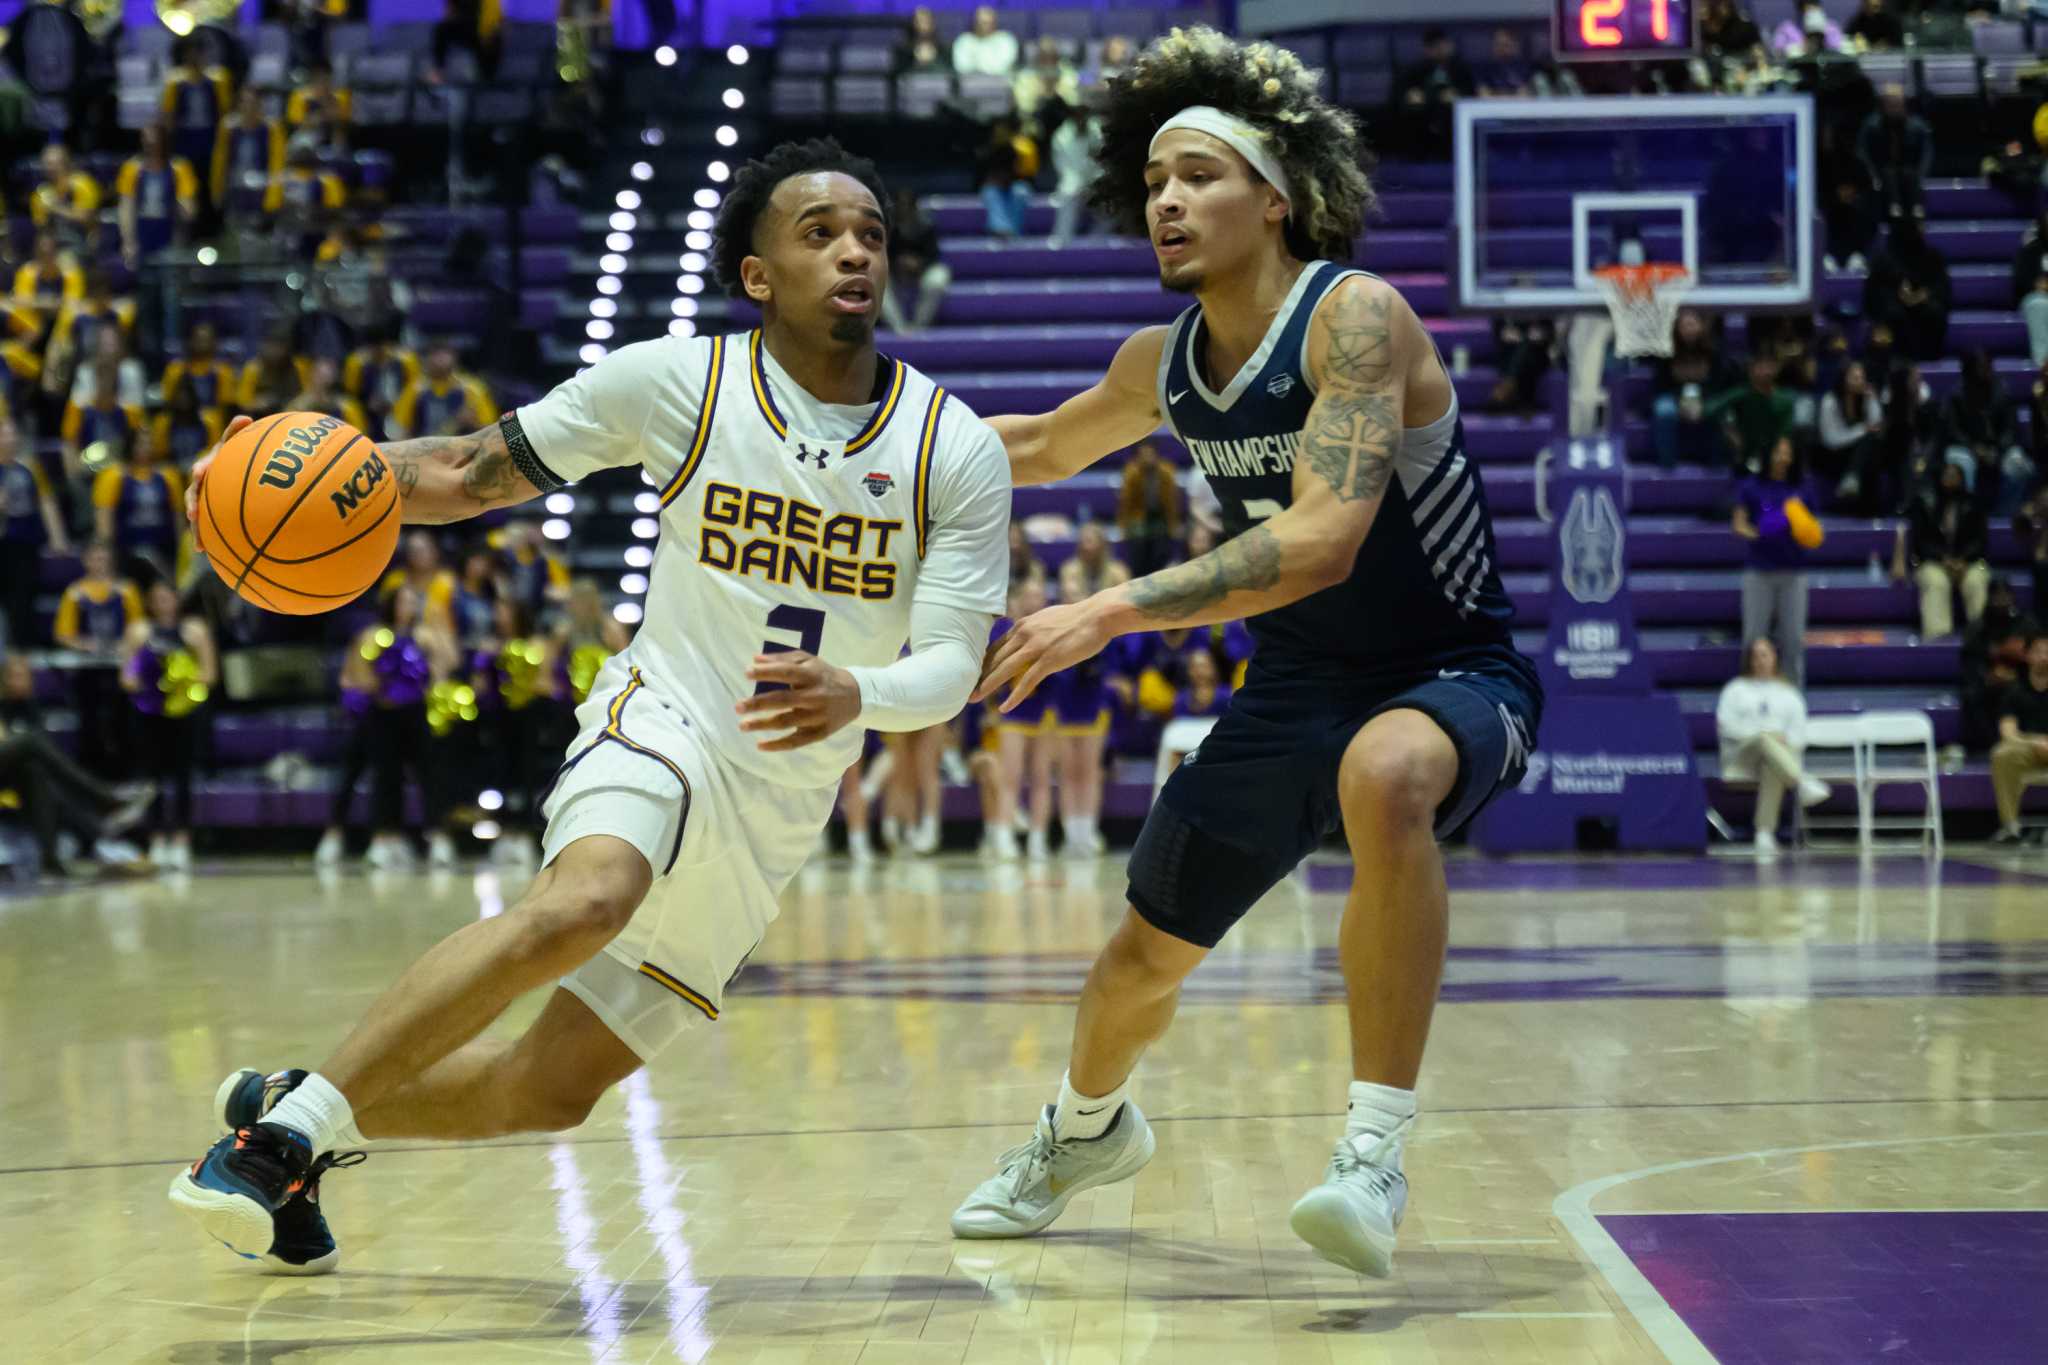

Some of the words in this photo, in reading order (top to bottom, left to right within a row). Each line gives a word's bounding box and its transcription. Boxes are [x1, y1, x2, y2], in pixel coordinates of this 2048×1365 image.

[258, 415, 347, 490] Wilson
[331, 451, 388, 519] NCAA
[702, 479, 904, 558] GREAT
[698, 526, 898, 602] DANES
